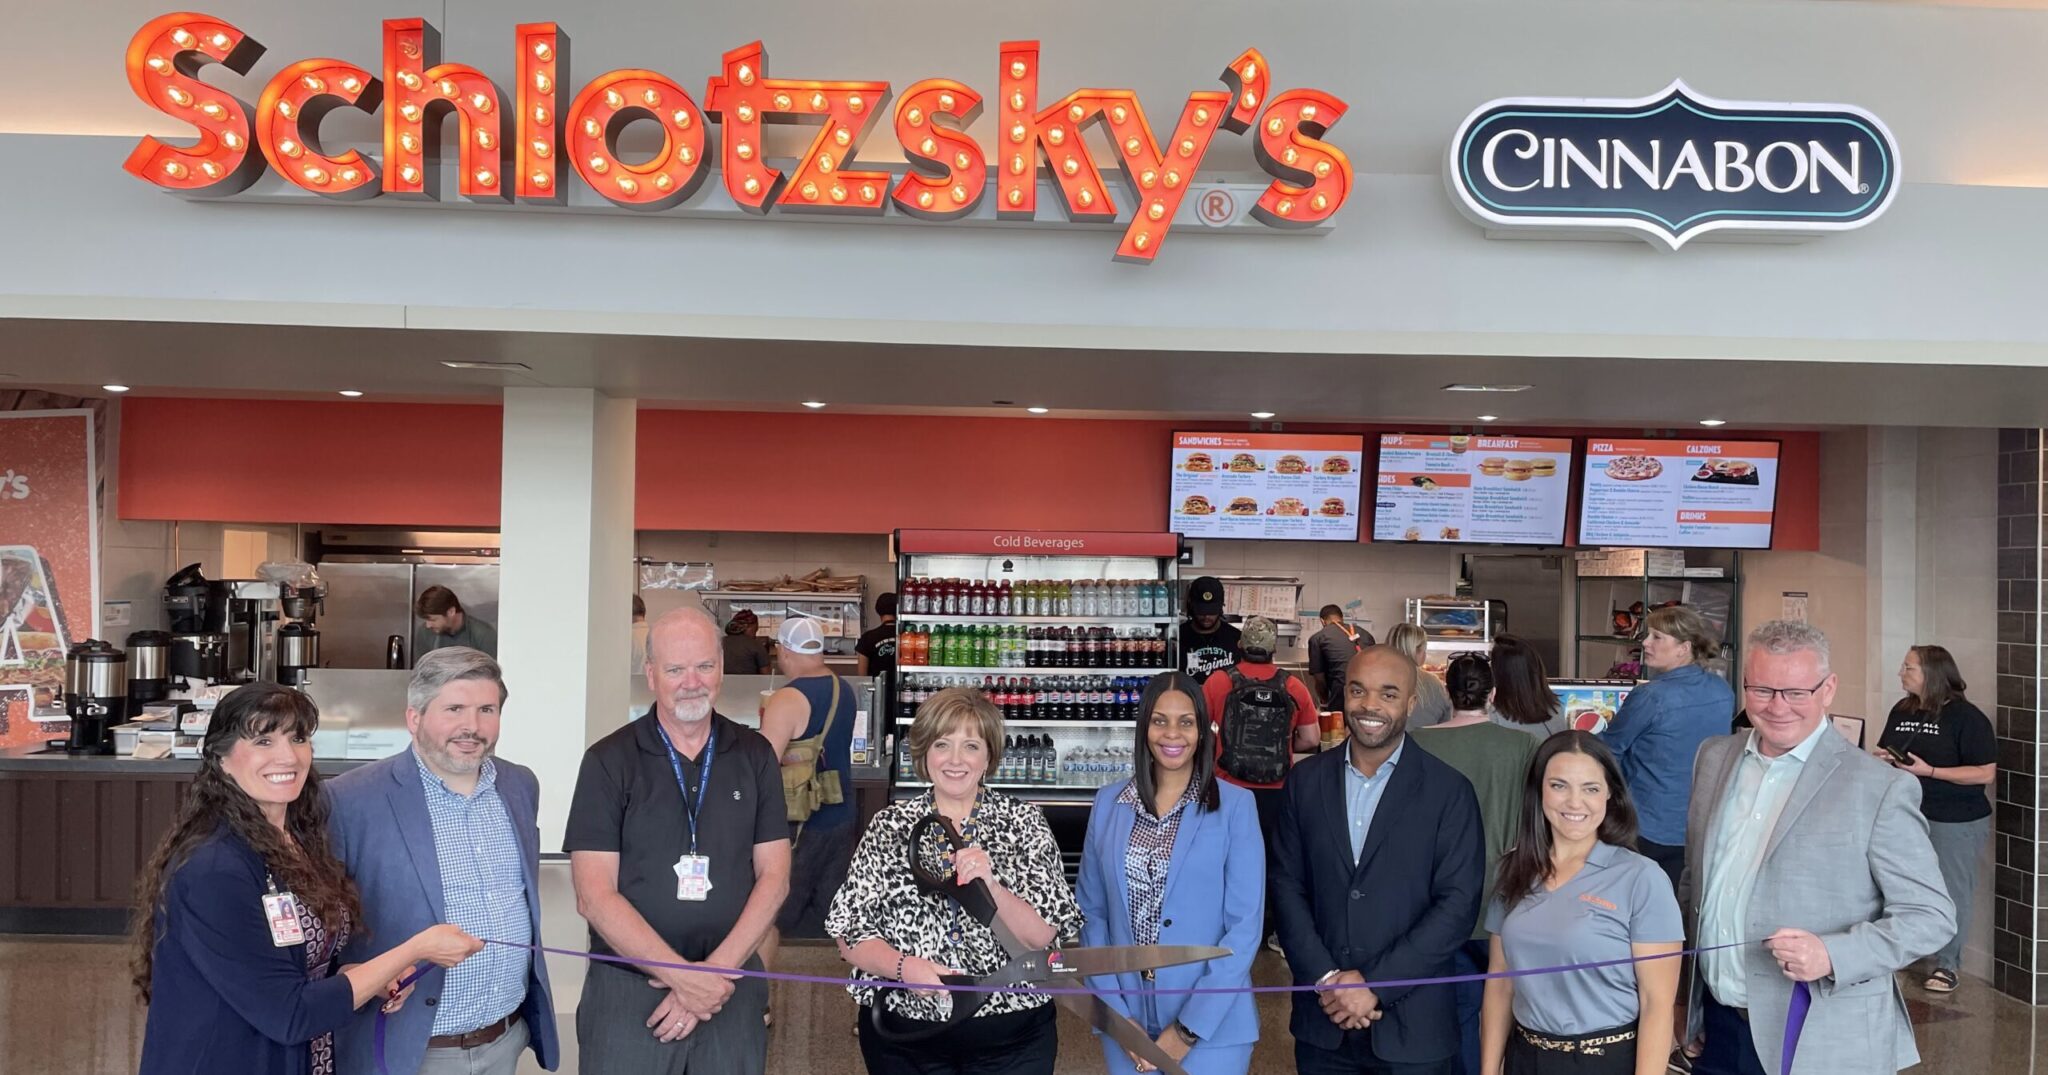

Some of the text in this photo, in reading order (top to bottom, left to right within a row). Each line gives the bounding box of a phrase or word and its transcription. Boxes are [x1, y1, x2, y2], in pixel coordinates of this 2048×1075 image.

[122, 17, 1354, 265] Schlotzsky's
[1178, 436, 1222, 446] SANDWICHES
[1476, 439, 1519, 449] BREAKFAST
[1592, 443, 1614, 452] PIZZA
[1686, 445, 1722, 454] CALZONES
[1680, 511, 1706, 521] DRINKS
[993, 535, 1085, 551] Cold Beverages
